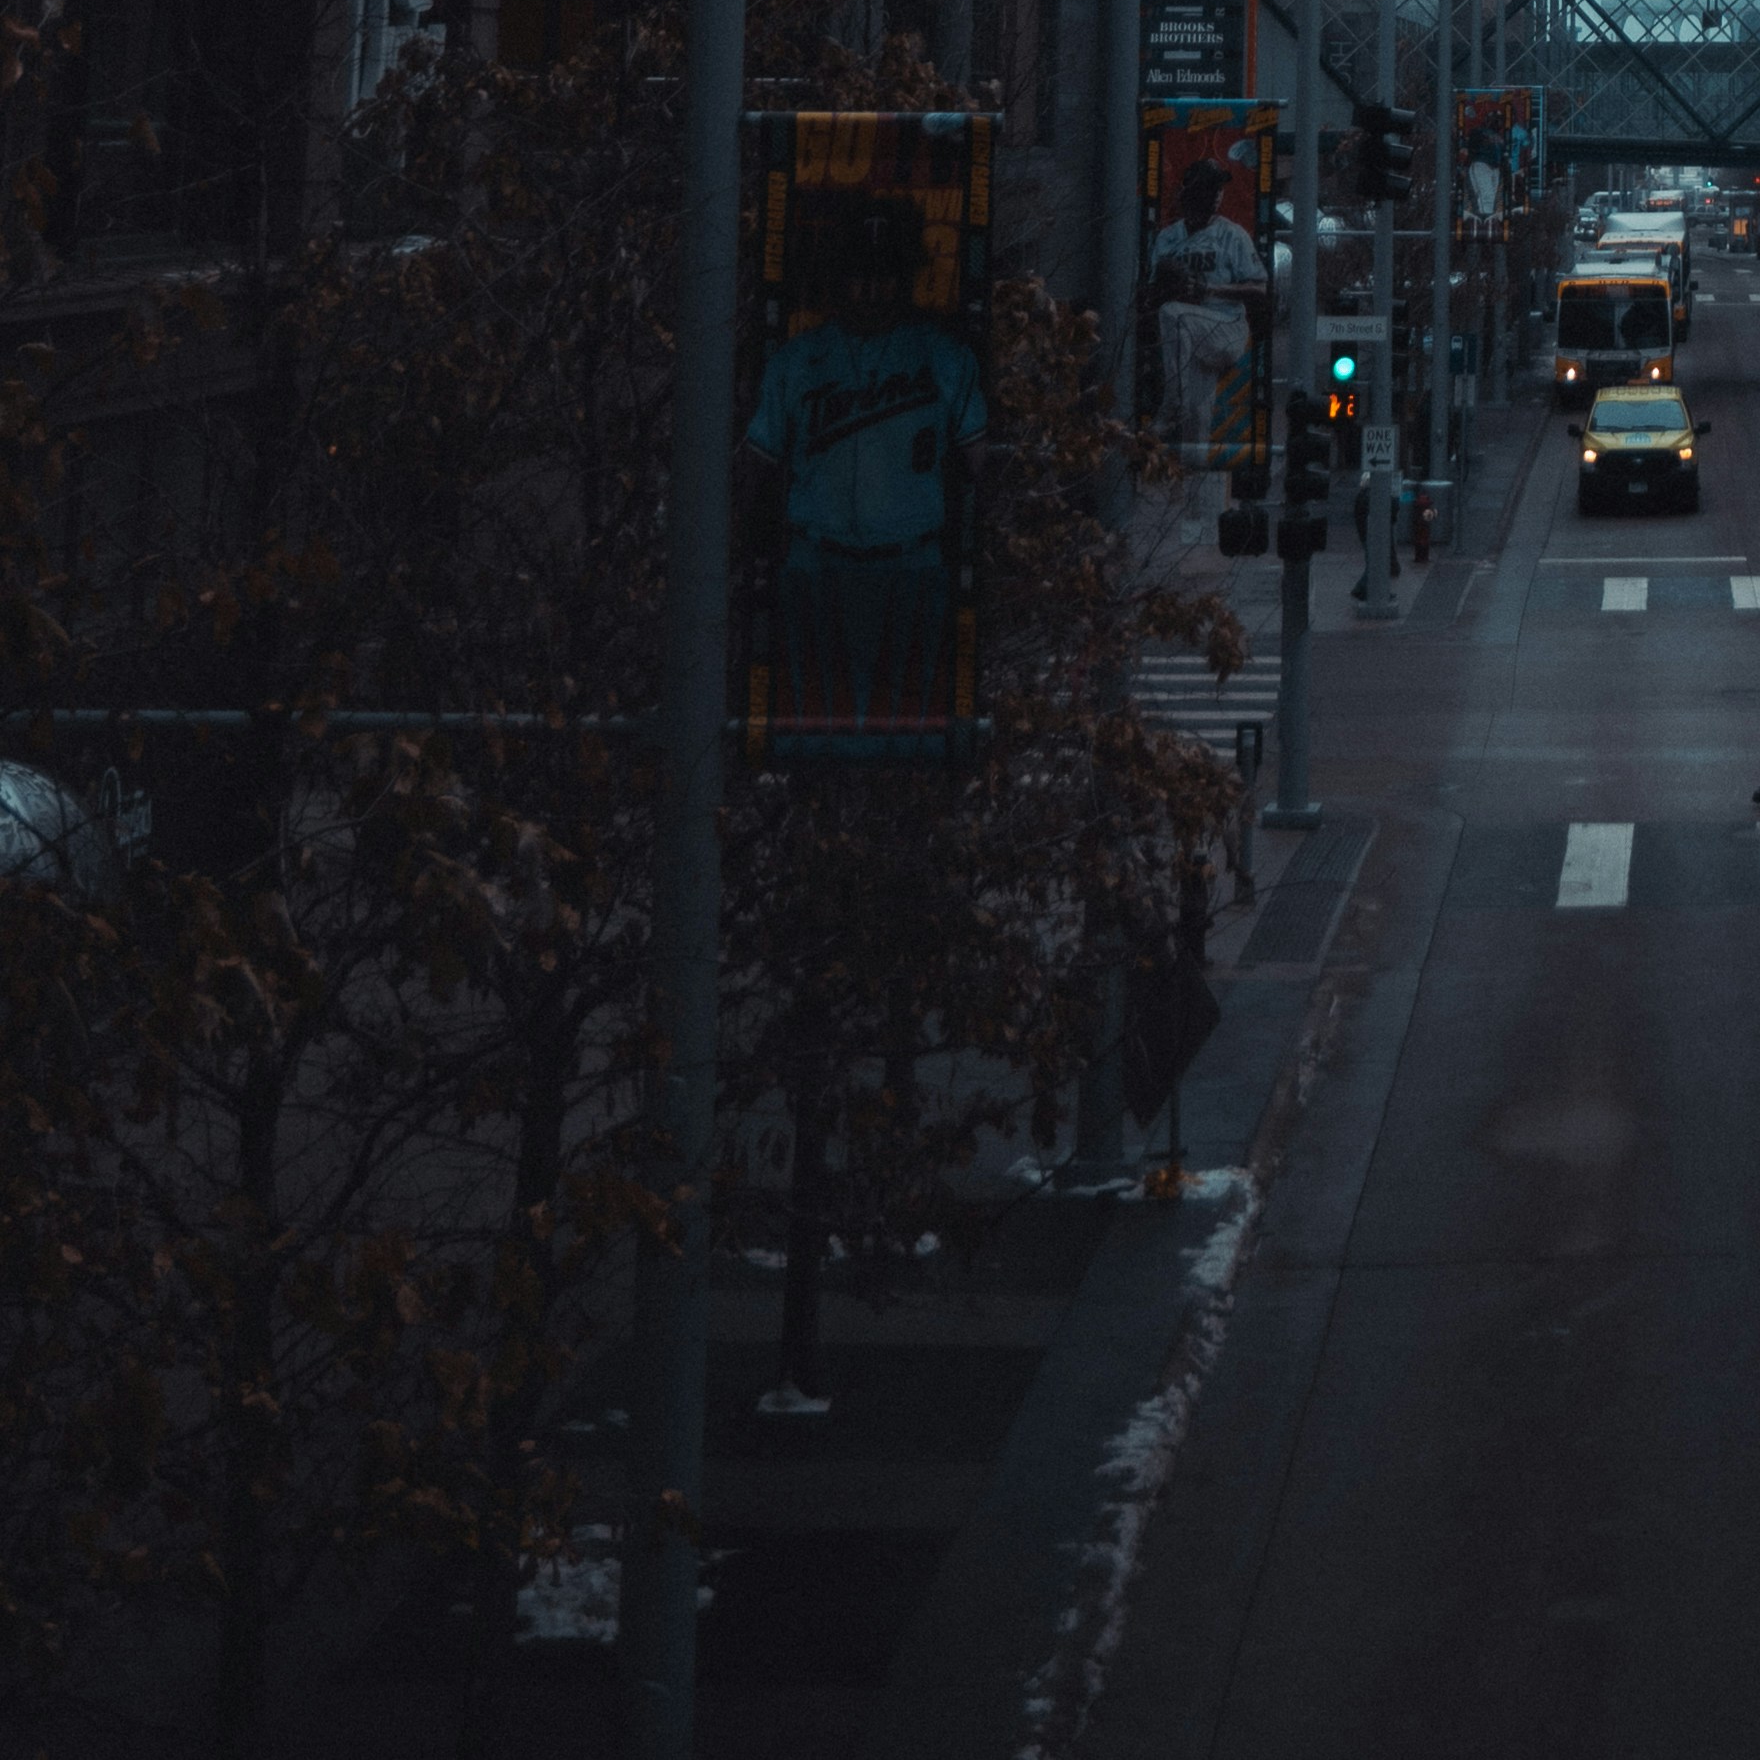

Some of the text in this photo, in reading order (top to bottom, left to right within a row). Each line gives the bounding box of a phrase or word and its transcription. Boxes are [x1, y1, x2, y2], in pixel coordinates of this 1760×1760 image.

[1159, 22, 1215, 32] BROOKS
[1150, 33, 1224, 44] BROTHERS
[1146, 69, 1226, 83] Allen Edmonds
[1329, 322, 1345, 333] 7th
[1347, 322, 1374, 334] Street
[1366, 431, 1392, 442] ONE
[1366, 442, 1393, 454] WAY
